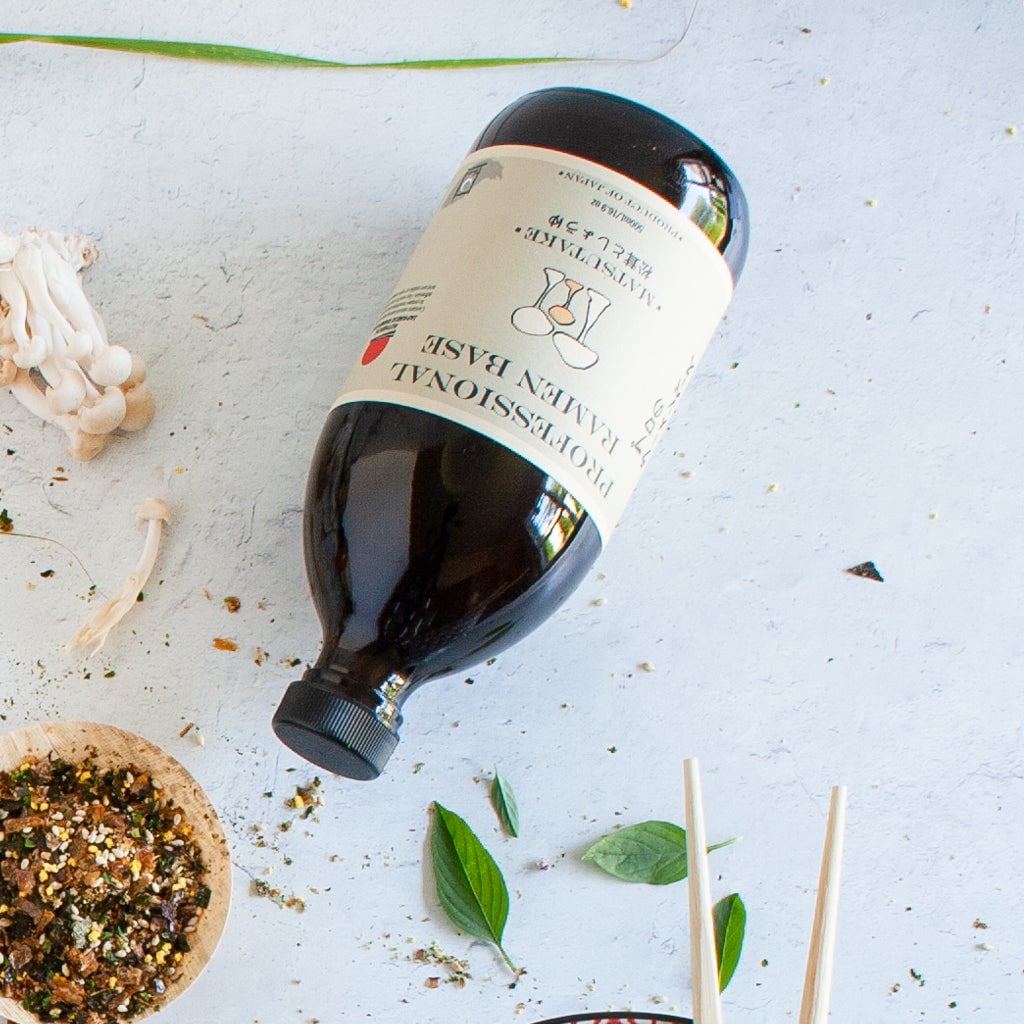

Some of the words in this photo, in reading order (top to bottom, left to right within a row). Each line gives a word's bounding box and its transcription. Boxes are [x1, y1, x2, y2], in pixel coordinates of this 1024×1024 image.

[565, 172, 606, 191] JAPAN
[606, 186, 624, 202] OF
[548, 214, 655, 280] 松茸としょうゆ
[625, 199, 680, 240] PRODUCT
[525, 226, 656, 306] MATSUTAKE
[421, 334, 513, 379] BASE
[390, 362, 615, 499] PROFESSIONAL
[517, 369, 620, 455] RAMEN
